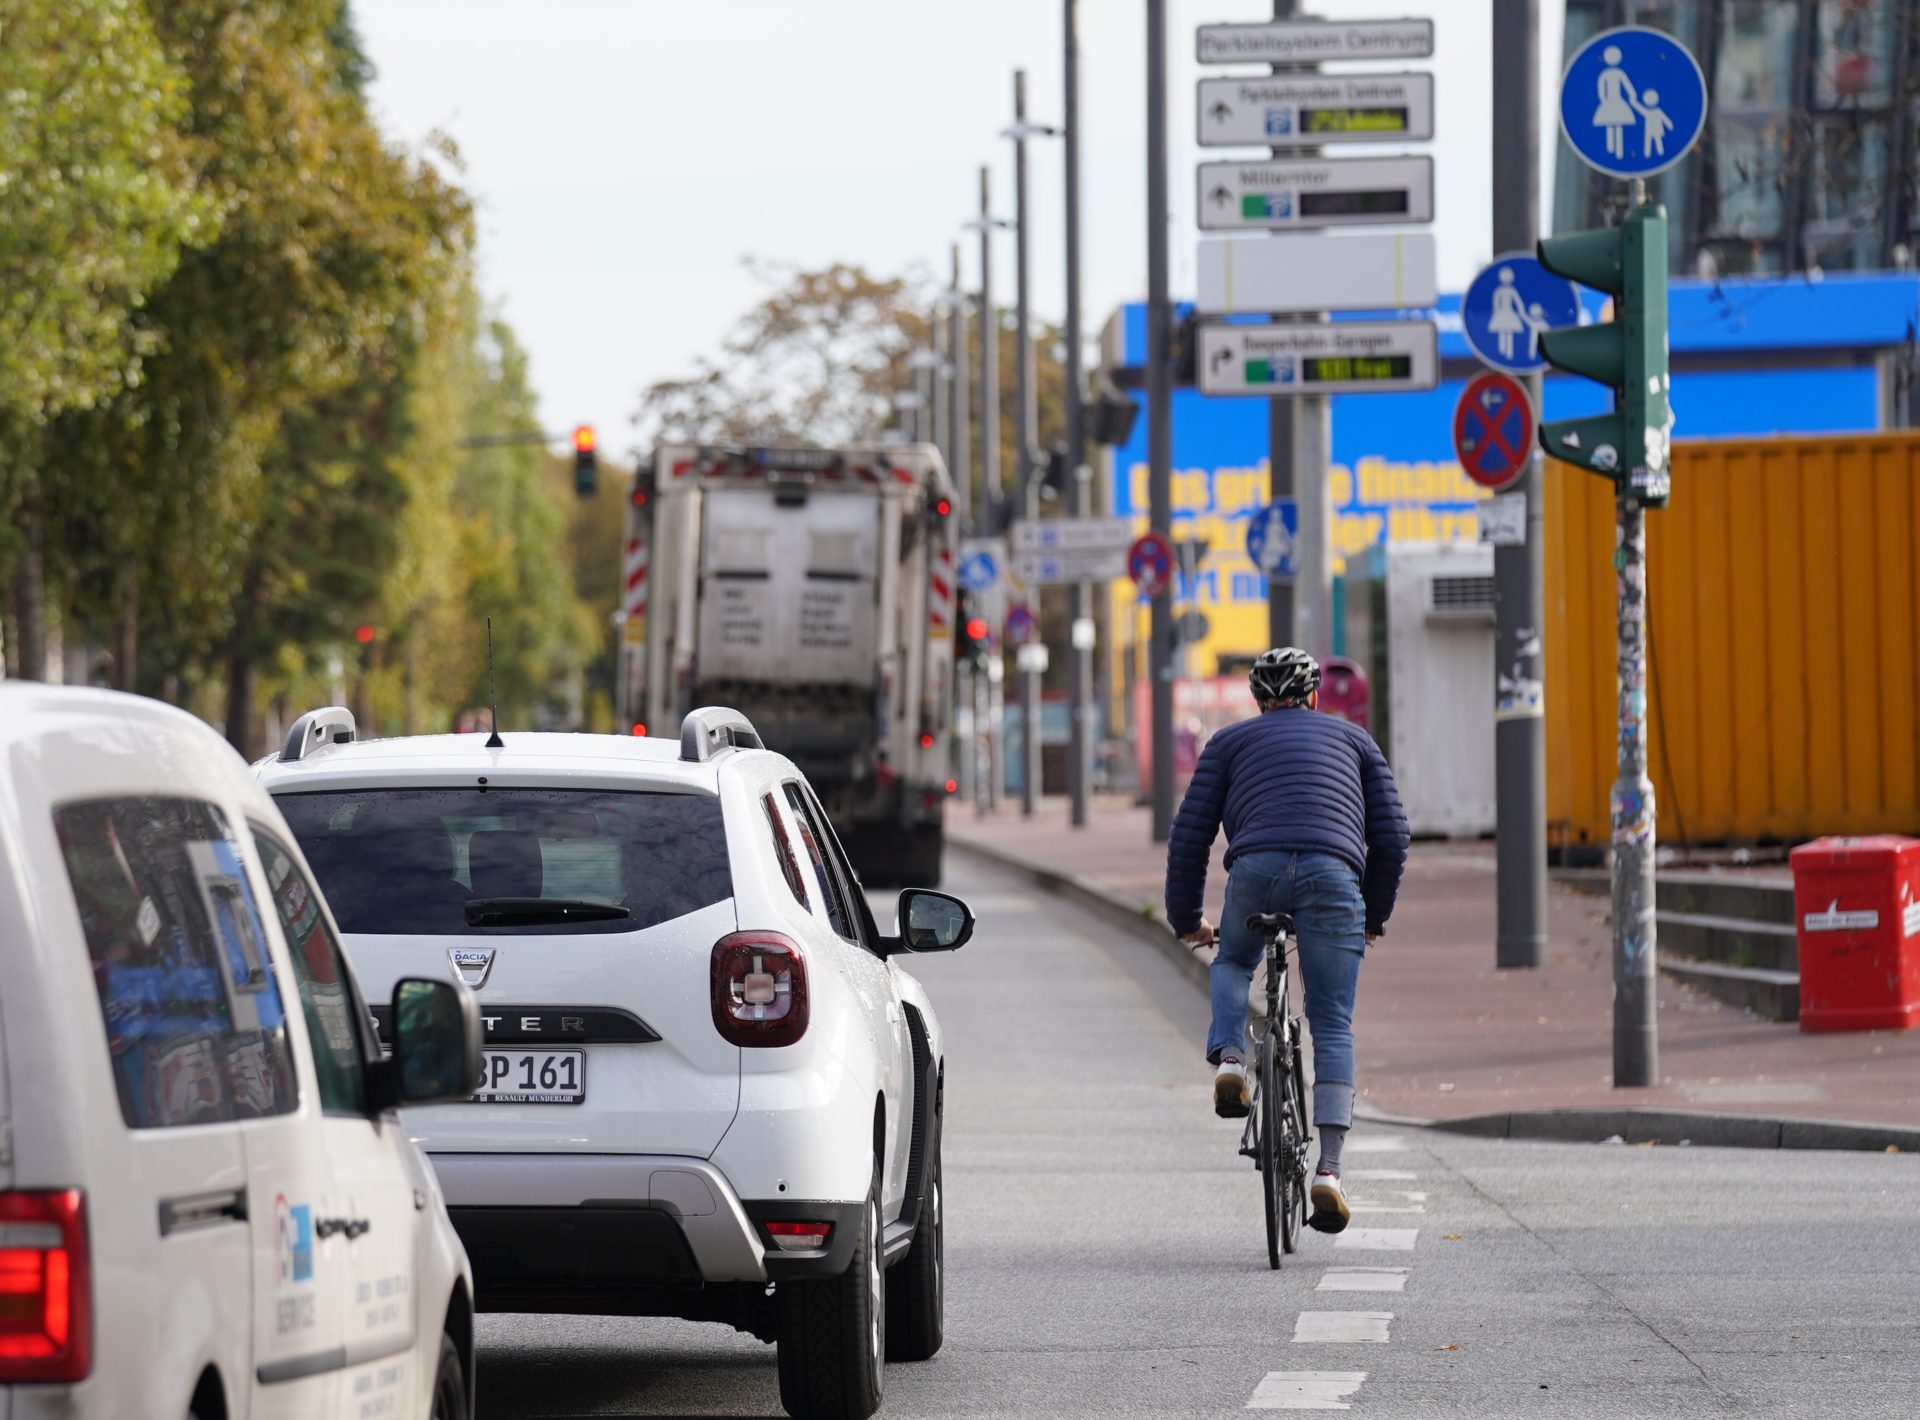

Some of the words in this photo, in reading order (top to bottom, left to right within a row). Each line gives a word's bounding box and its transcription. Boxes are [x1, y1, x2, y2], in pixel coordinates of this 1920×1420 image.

[455, 950, 487, 961] DACIA
[480, 1016, 584, 1031] TER
[519, 1056, 577, 1090] 161
[495, 1094, 526, 1102] RENAULT
